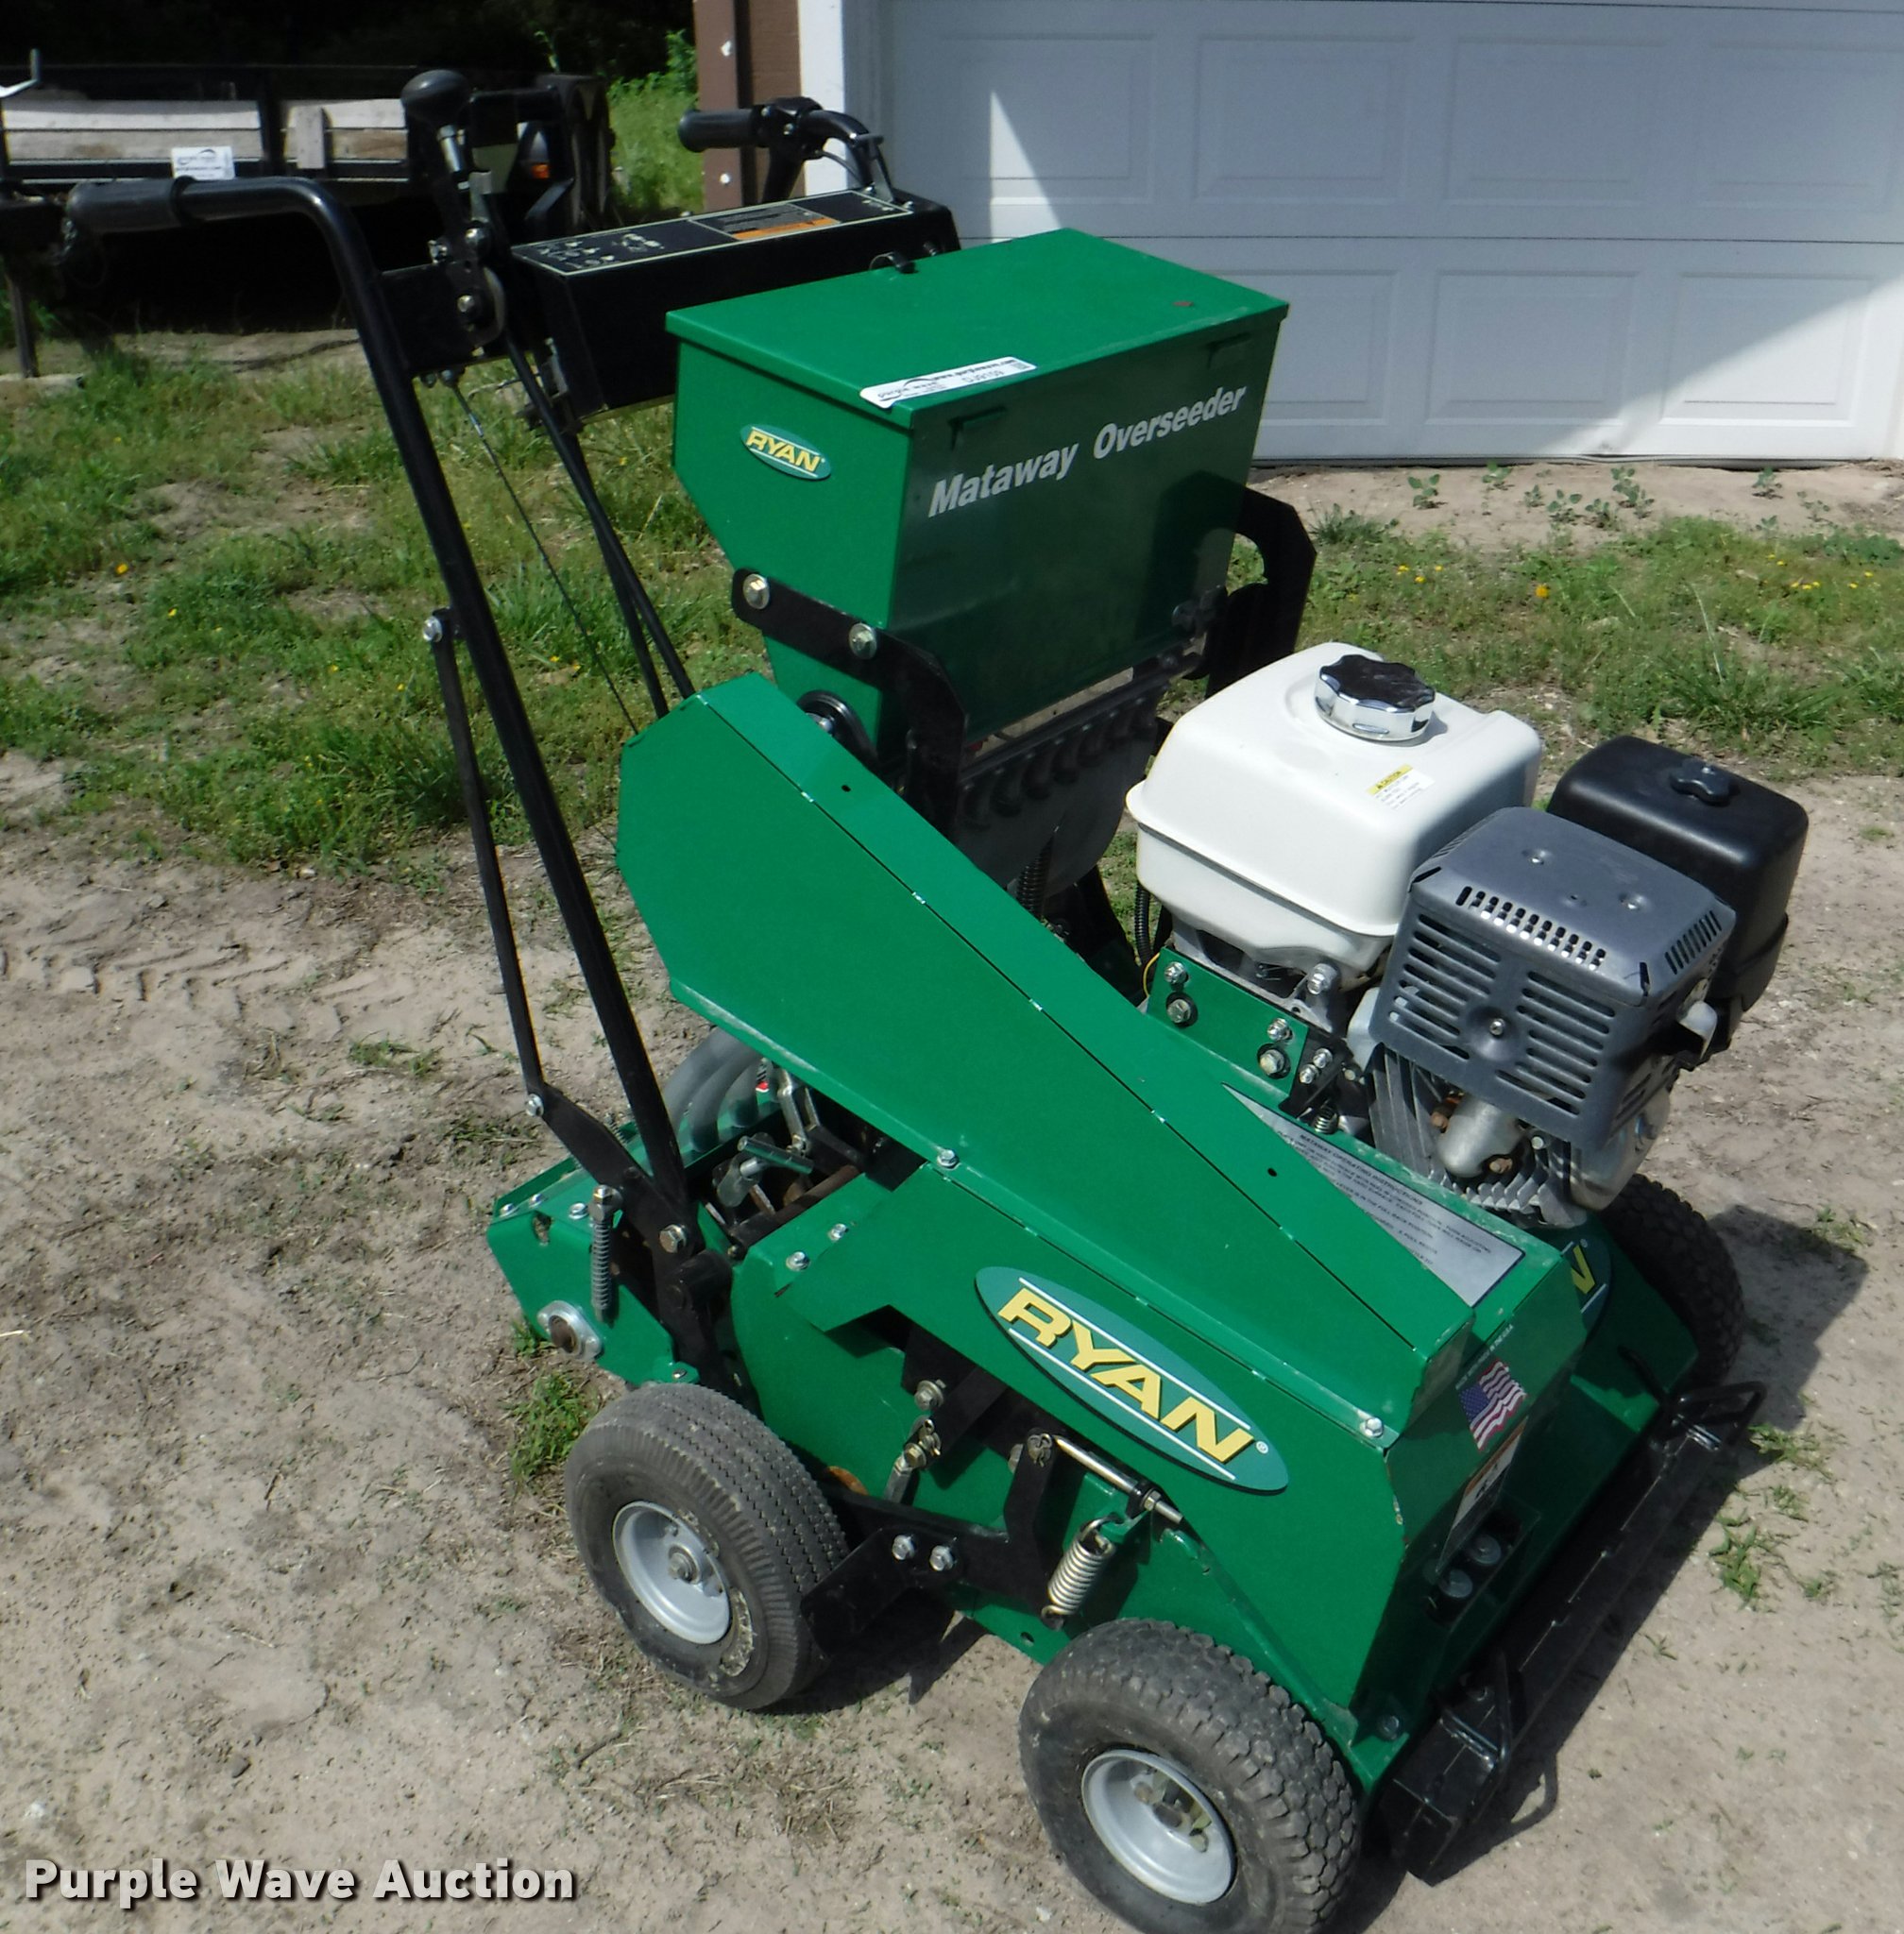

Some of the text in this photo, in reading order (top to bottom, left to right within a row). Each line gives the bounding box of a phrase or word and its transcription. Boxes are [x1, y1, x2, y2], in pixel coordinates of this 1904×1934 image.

[927, 386, 1247, 518] Mataway Overseeder
[997, 1287, 1255, 1463] RYAN
